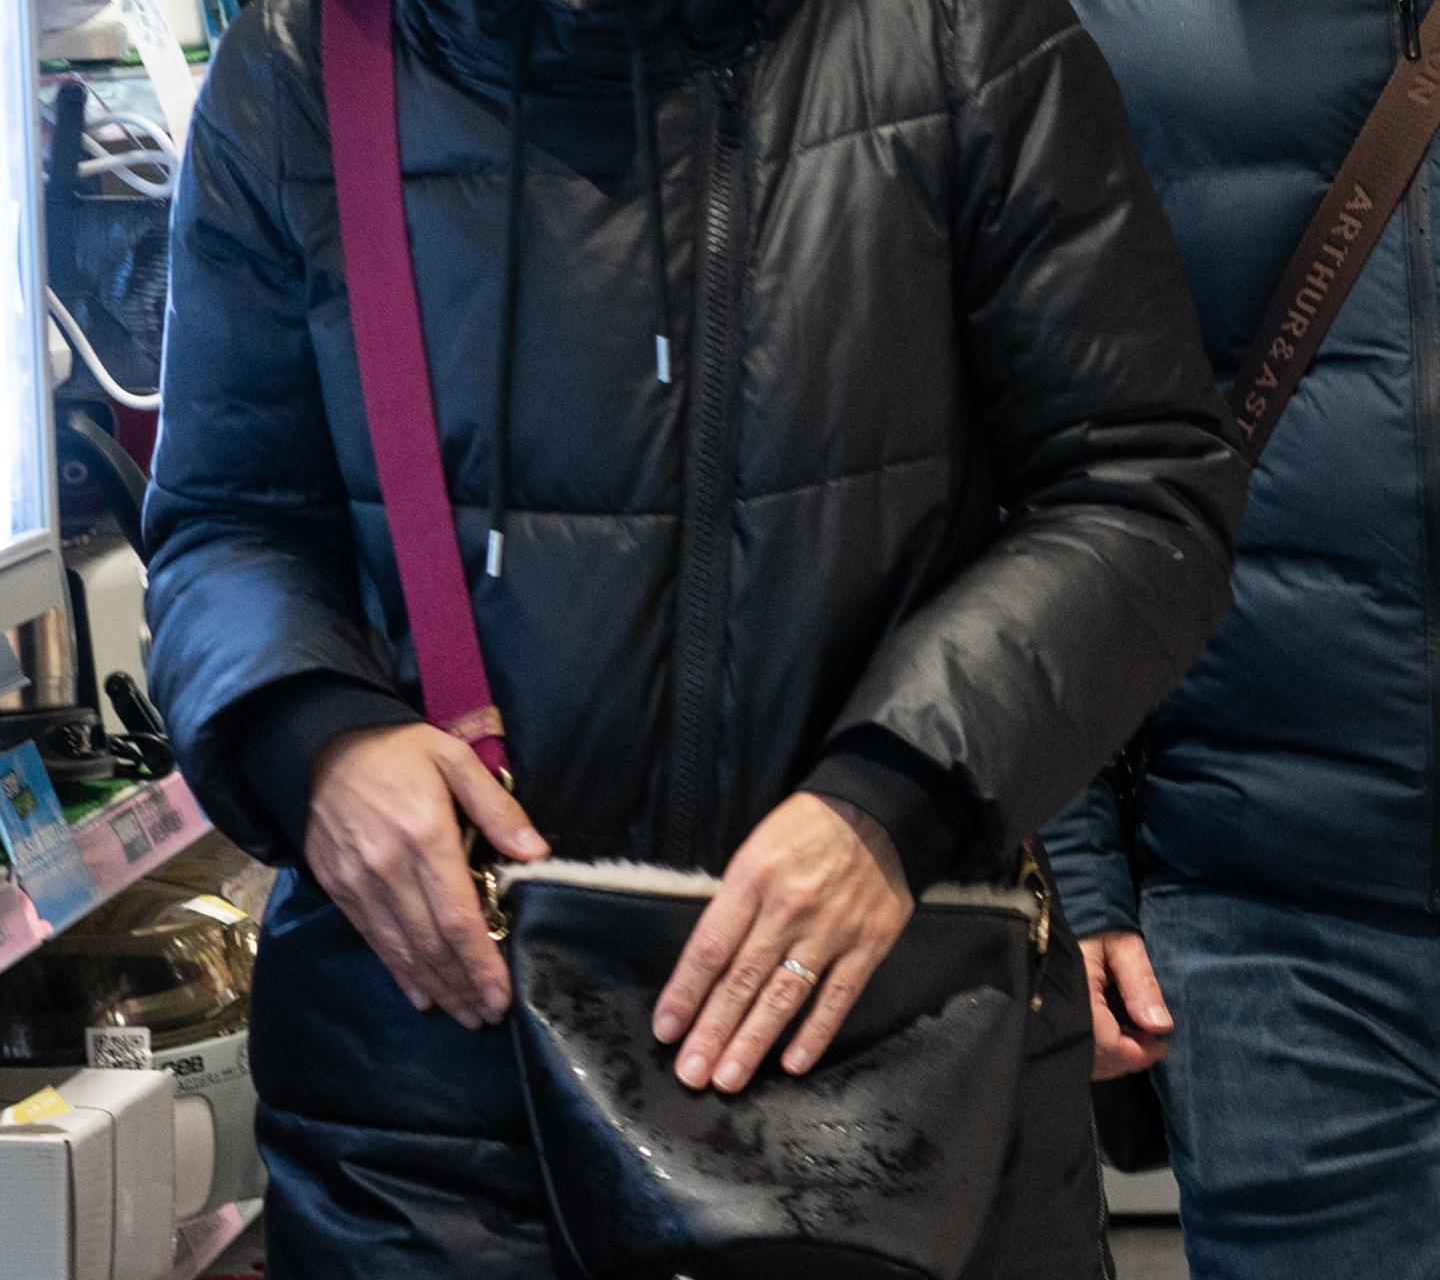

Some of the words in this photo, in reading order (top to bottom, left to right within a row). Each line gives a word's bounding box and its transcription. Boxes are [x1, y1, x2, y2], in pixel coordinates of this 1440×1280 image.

[1286, 183, 1375, 341] ARTHUR
[1268, 337, 1296, 363] &
[1235, 370, 1281, 441] AST
